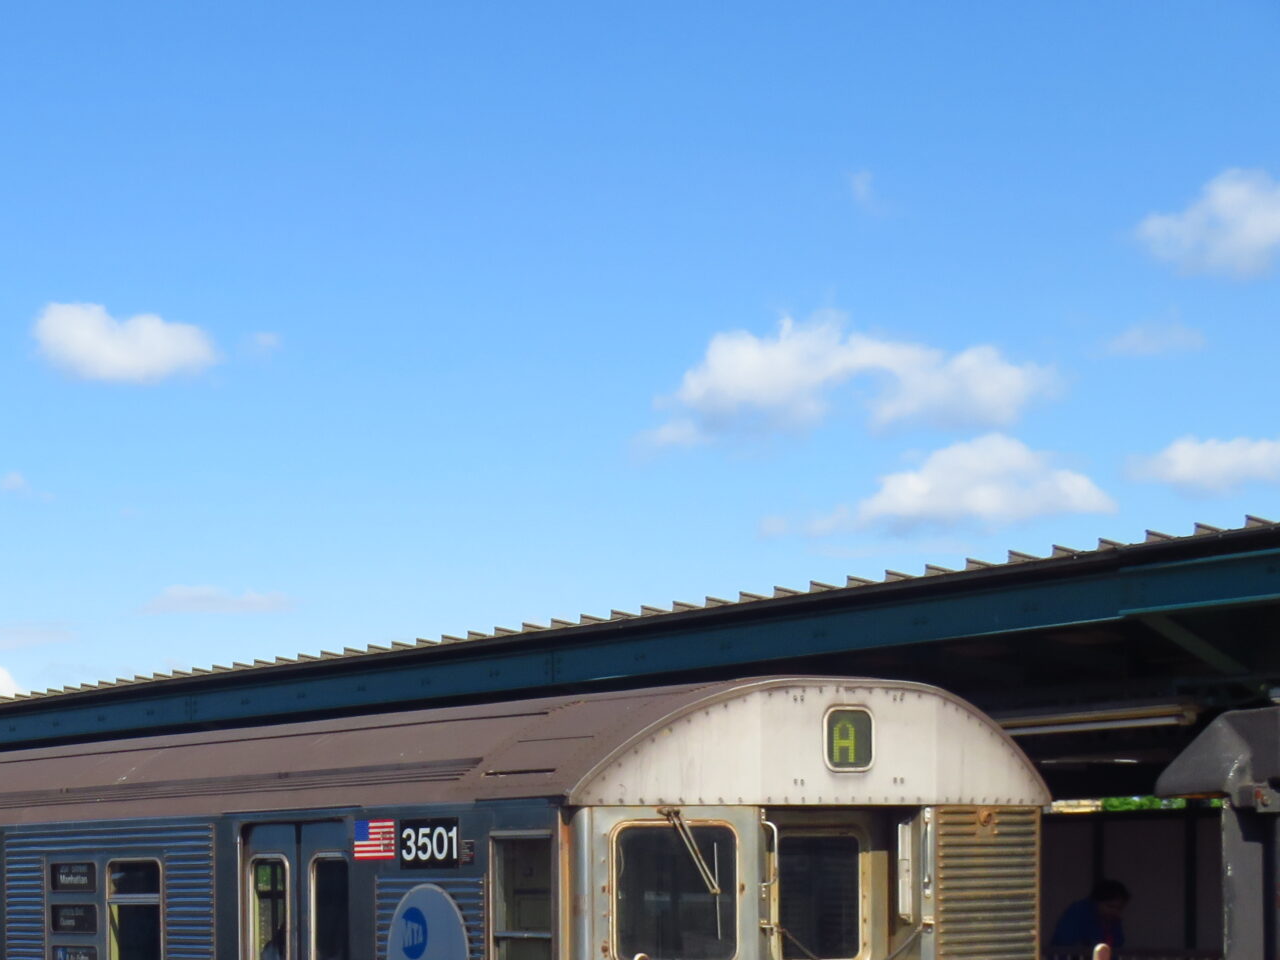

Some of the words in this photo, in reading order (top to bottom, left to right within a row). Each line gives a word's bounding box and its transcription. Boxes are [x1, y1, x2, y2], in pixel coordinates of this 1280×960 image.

[833, 719, 855, 763] A
[401, 826, 458, 861] 3501
[402, 918, 424, 947] MTA
